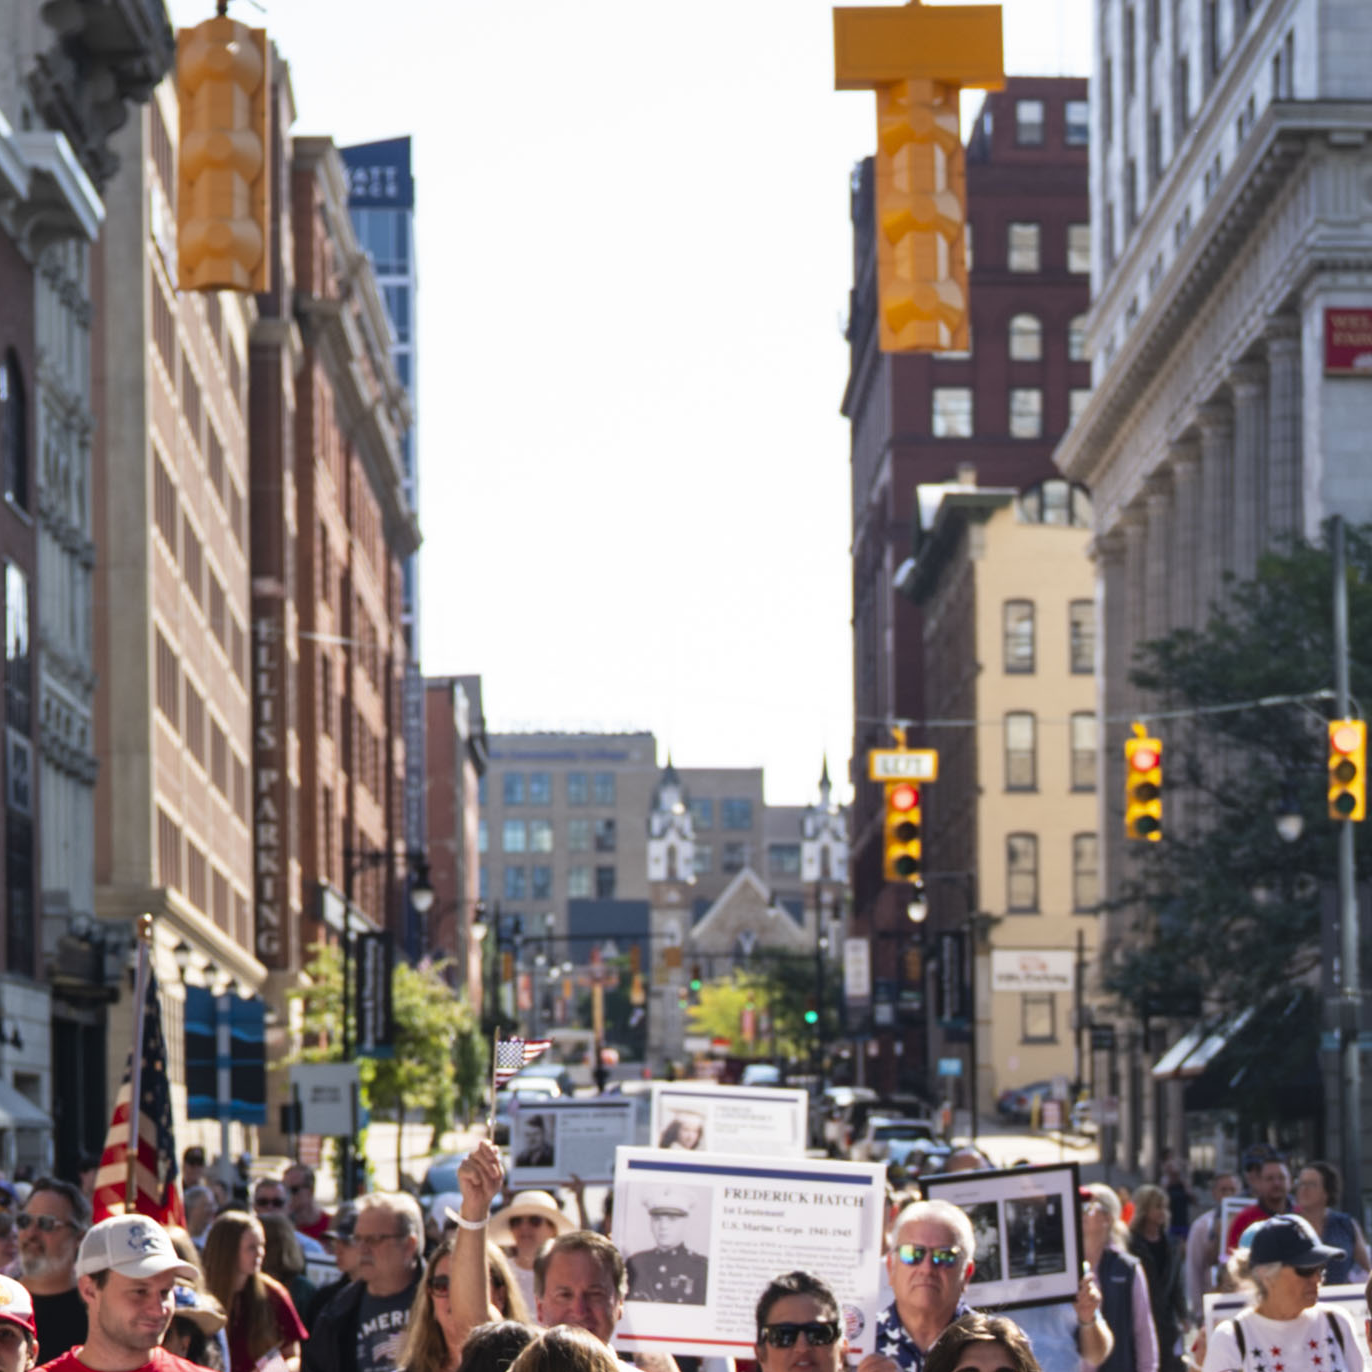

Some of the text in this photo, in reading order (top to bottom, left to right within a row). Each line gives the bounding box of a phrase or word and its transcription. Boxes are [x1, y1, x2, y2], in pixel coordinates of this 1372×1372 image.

[257, 617, 278, 954] ELLIS PARKING
[724, 1187, 865, 1208] FREDERICK HATCH
